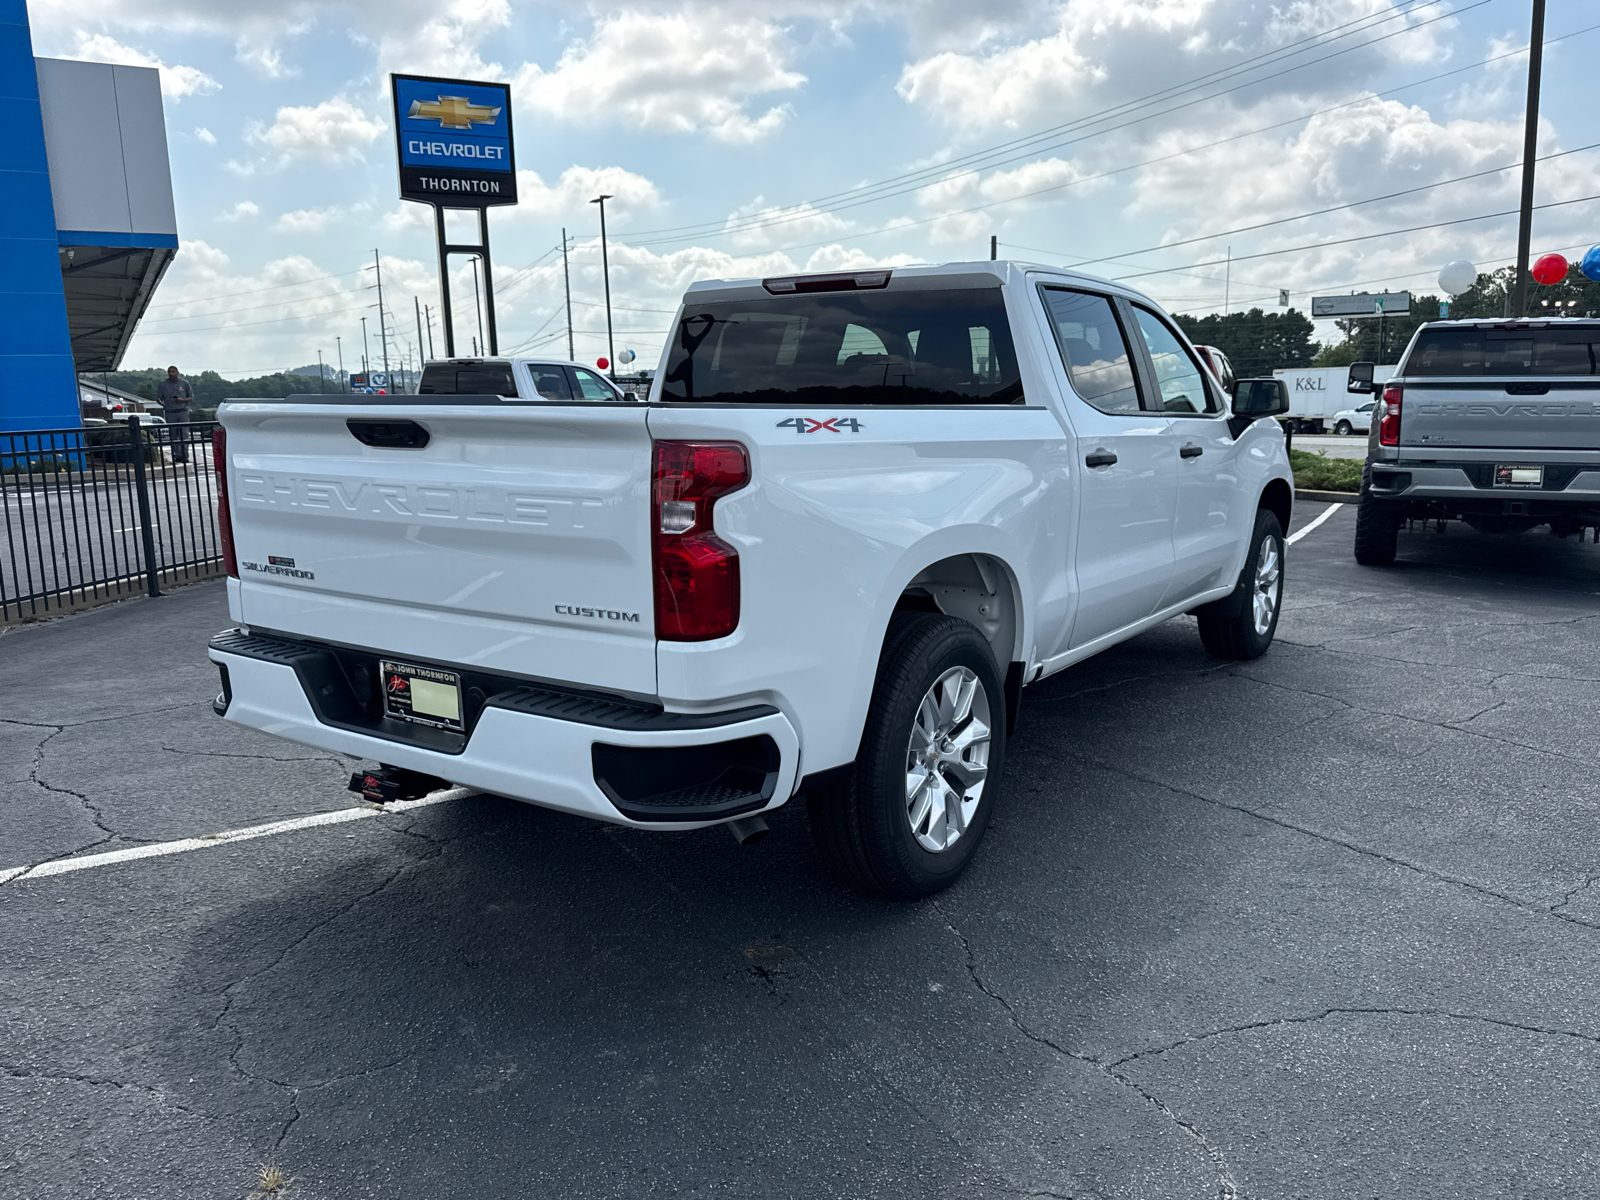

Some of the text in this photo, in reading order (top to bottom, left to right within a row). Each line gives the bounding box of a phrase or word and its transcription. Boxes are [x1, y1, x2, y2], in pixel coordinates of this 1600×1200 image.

[408, 140, 504, 160] CHEVROLET
[420, 177, 500, 193] THORNTON
[1295, 377, 1326, 391] K&L
[240, 474, 605, 529] CHEVROLET
[242, 561, 315, 580] SILVERADO
[555, 604, 640, 622] CUSTOM
[397, 665, 455, 682] JOHN THORNTON
